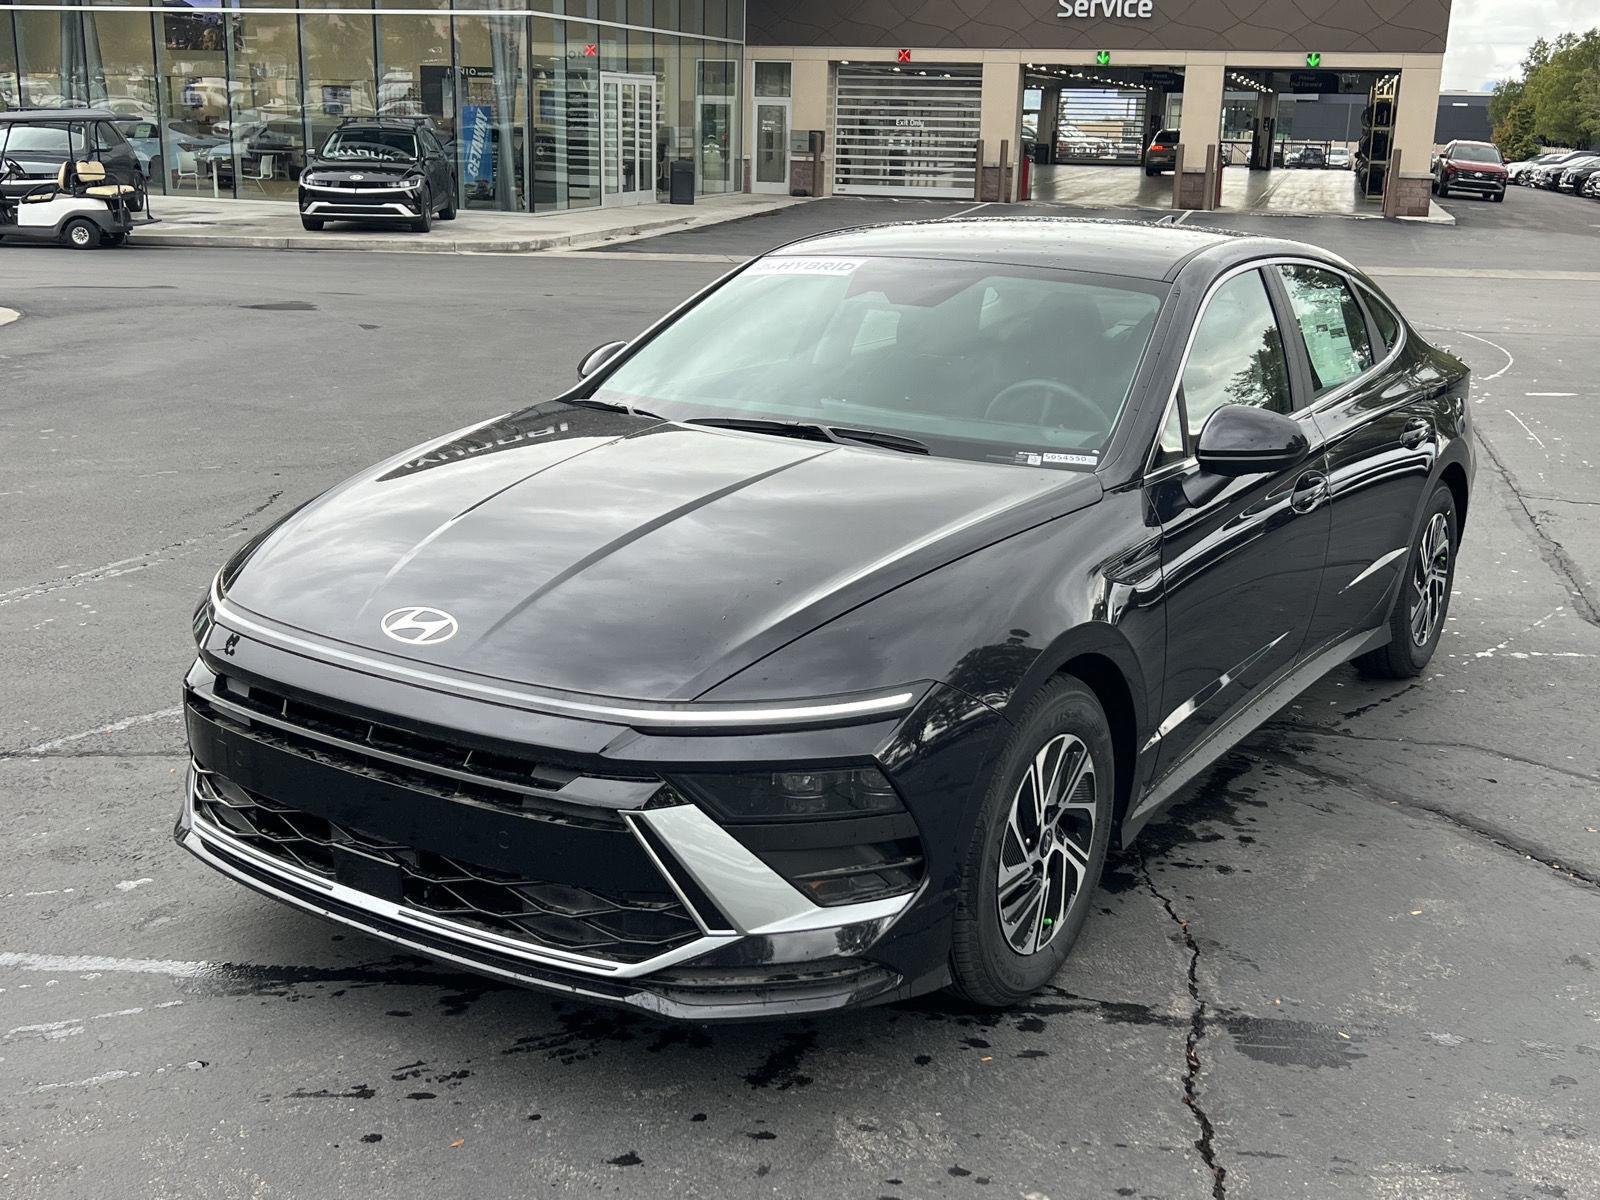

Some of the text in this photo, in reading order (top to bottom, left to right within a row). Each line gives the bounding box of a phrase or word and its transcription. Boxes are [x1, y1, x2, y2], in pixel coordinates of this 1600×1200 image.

[1057, 0, 1153, 18] Service
[895, 118, 925, 129] Exit Only
[467, 107, 488, 178] GETAWAY
